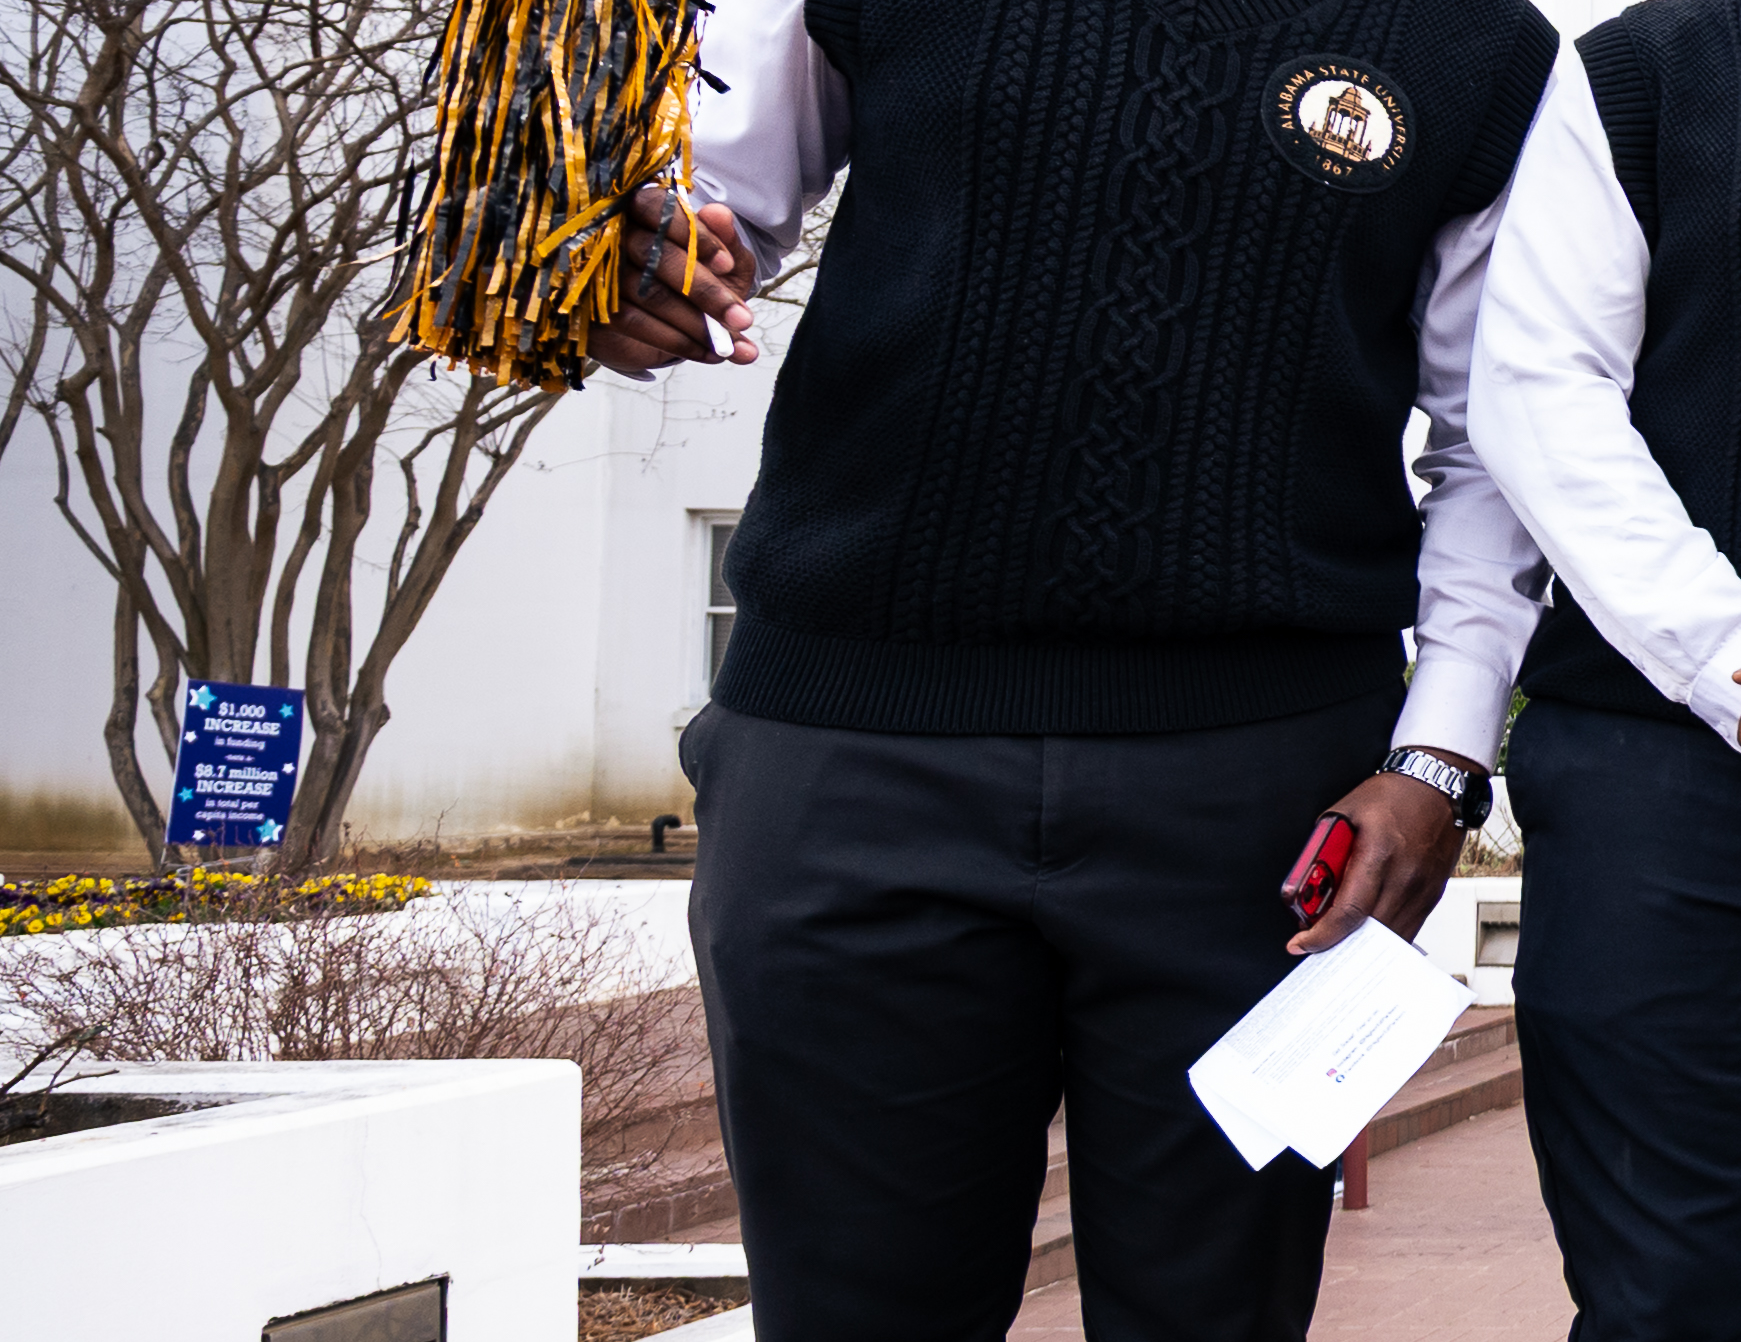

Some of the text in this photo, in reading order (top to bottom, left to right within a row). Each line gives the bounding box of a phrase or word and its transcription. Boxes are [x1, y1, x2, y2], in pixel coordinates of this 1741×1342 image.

[1277, 69, 1315, 130] ALABAMA
[1318, 65, 1370, 84] STATE
[1314, 154, 1353, 176] 1867
[218, 701, 266, 718] $1,000
[204, 718, 281, 734] INCREASE
[226, 737, 266, 750] funding
[228, 766, 278, 781] million
[196, 780, 273, 796] INCREASE
